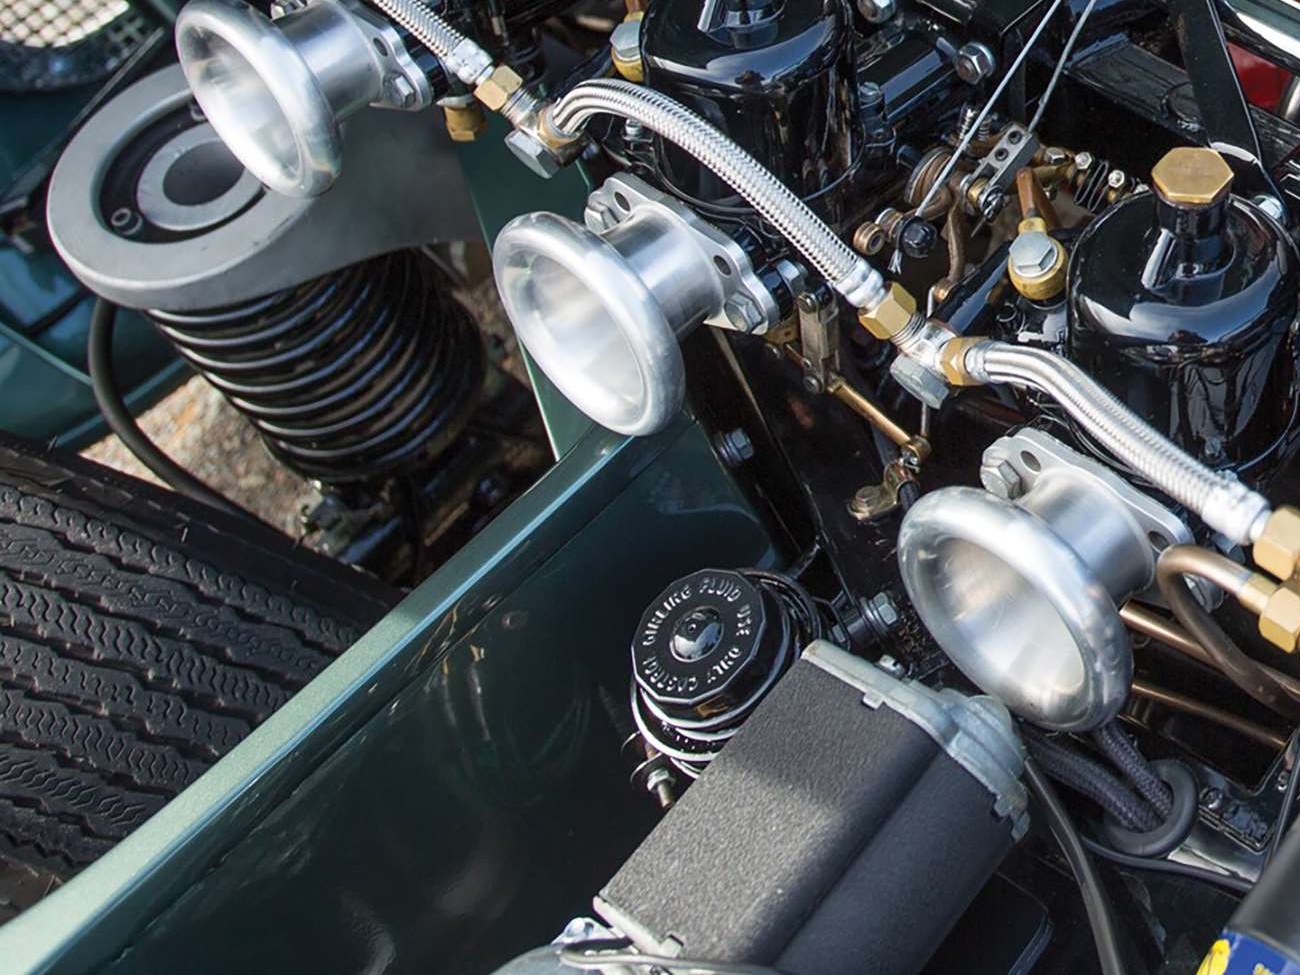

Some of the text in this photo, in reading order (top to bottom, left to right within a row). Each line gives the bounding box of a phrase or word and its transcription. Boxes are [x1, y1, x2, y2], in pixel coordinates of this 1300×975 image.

[699, 578, 742, 602] FLUID
[642, 585, 692, 646] GIRLING
[736, 604, 752, 636] USE
